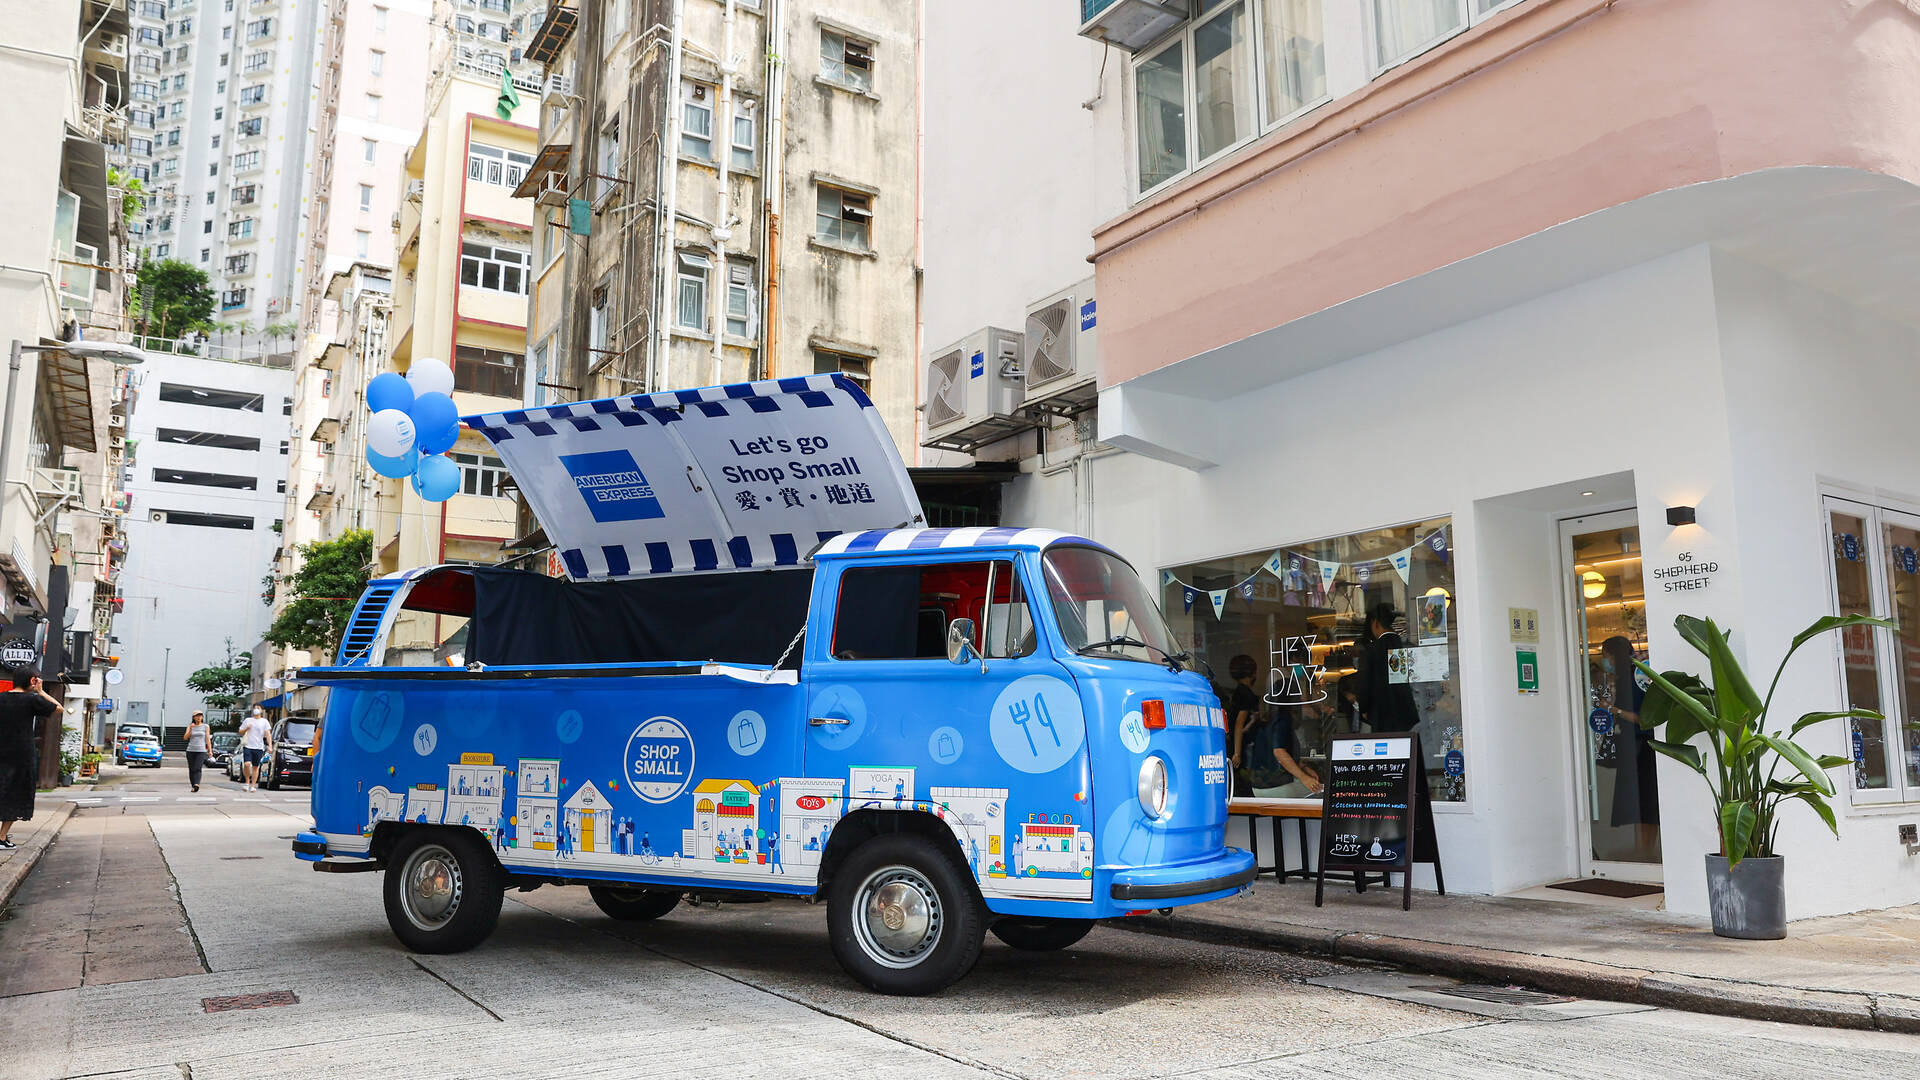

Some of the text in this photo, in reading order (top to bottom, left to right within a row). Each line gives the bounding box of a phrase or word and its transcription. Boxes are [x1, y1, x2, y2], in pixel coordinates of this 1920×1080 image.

[1081, 311, 1097, 323] Haie
[729, 436, 829, 456] Let's go
[722, 457, 862, 485] Shop Small
[575, 471, 643, 488] AMERICAN
[594, 486, 655, 502] EXPRESS
[1678, 552, 1693, 562] 05
[1653, 562, 1719, 579] SHEPHERD
[1664, 577, 1710, 593] STREET
[4, 650, 33, 660] ALL IN
[1269, 634, 1318, 668] HEY
[640, 744, 680, 760] SHOP
[634, 760, 683, 776] SMALL
[870, 773, 893, 783] YOGA
[802, 798, 820, 808] TOYS
[1028, 813, 1073, 825] FOOD
[1335, 834, 1358, 843] HEY
